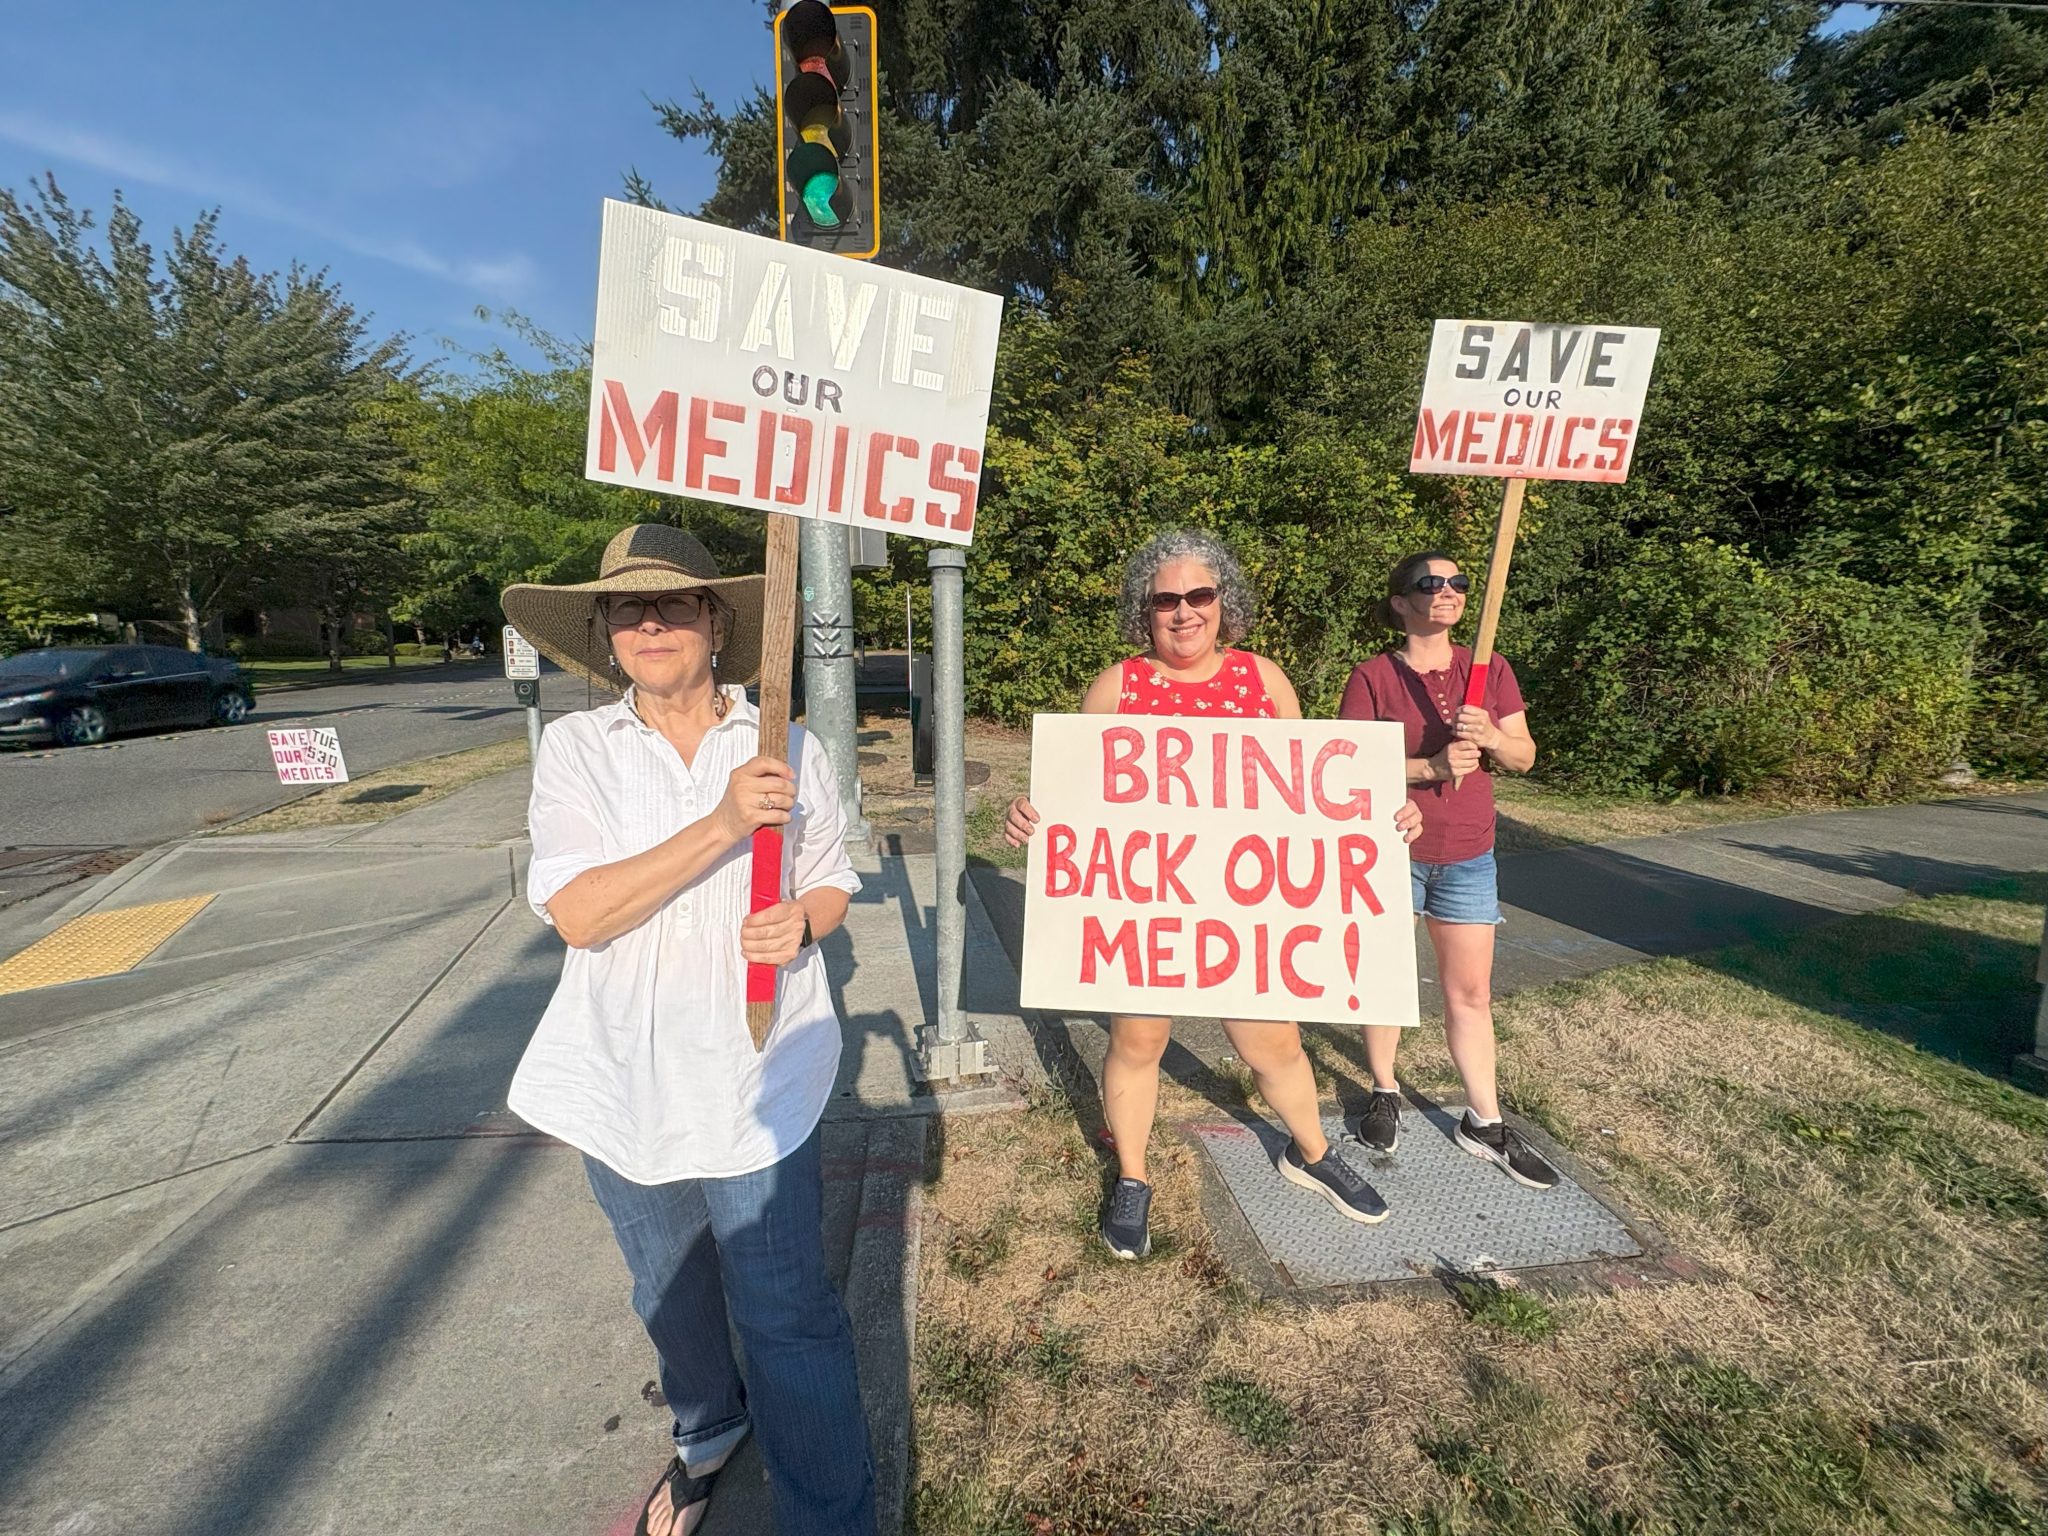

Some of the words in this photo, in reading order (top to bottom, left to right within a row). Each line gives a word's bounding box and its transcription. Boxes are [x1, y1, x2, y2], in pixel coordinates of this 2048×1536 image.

[659, 236, 954, 392] SAVE
[1455, 325, 1626, 387] SAVE
[752, 365, 843, 413] OUR
[1504, 388, 1562, 409] OUR
[598, 380, 980, 533] MEDICS
[1413, 408, 1634, 470] MEDICS
[269, 732, 308, 746] SAVE
[274, 750, 303, 763] OUR
[312, 729, 338, 750] TUE
[280, 767, 335, 781] MEDICS
[1102, 726, 1372, 821] BRING
[1045, 823, 1197, 904] BACK
[1225, 833, 1385, 916] OUR
[1079, 916, 1362, 1011] MEDIC!
